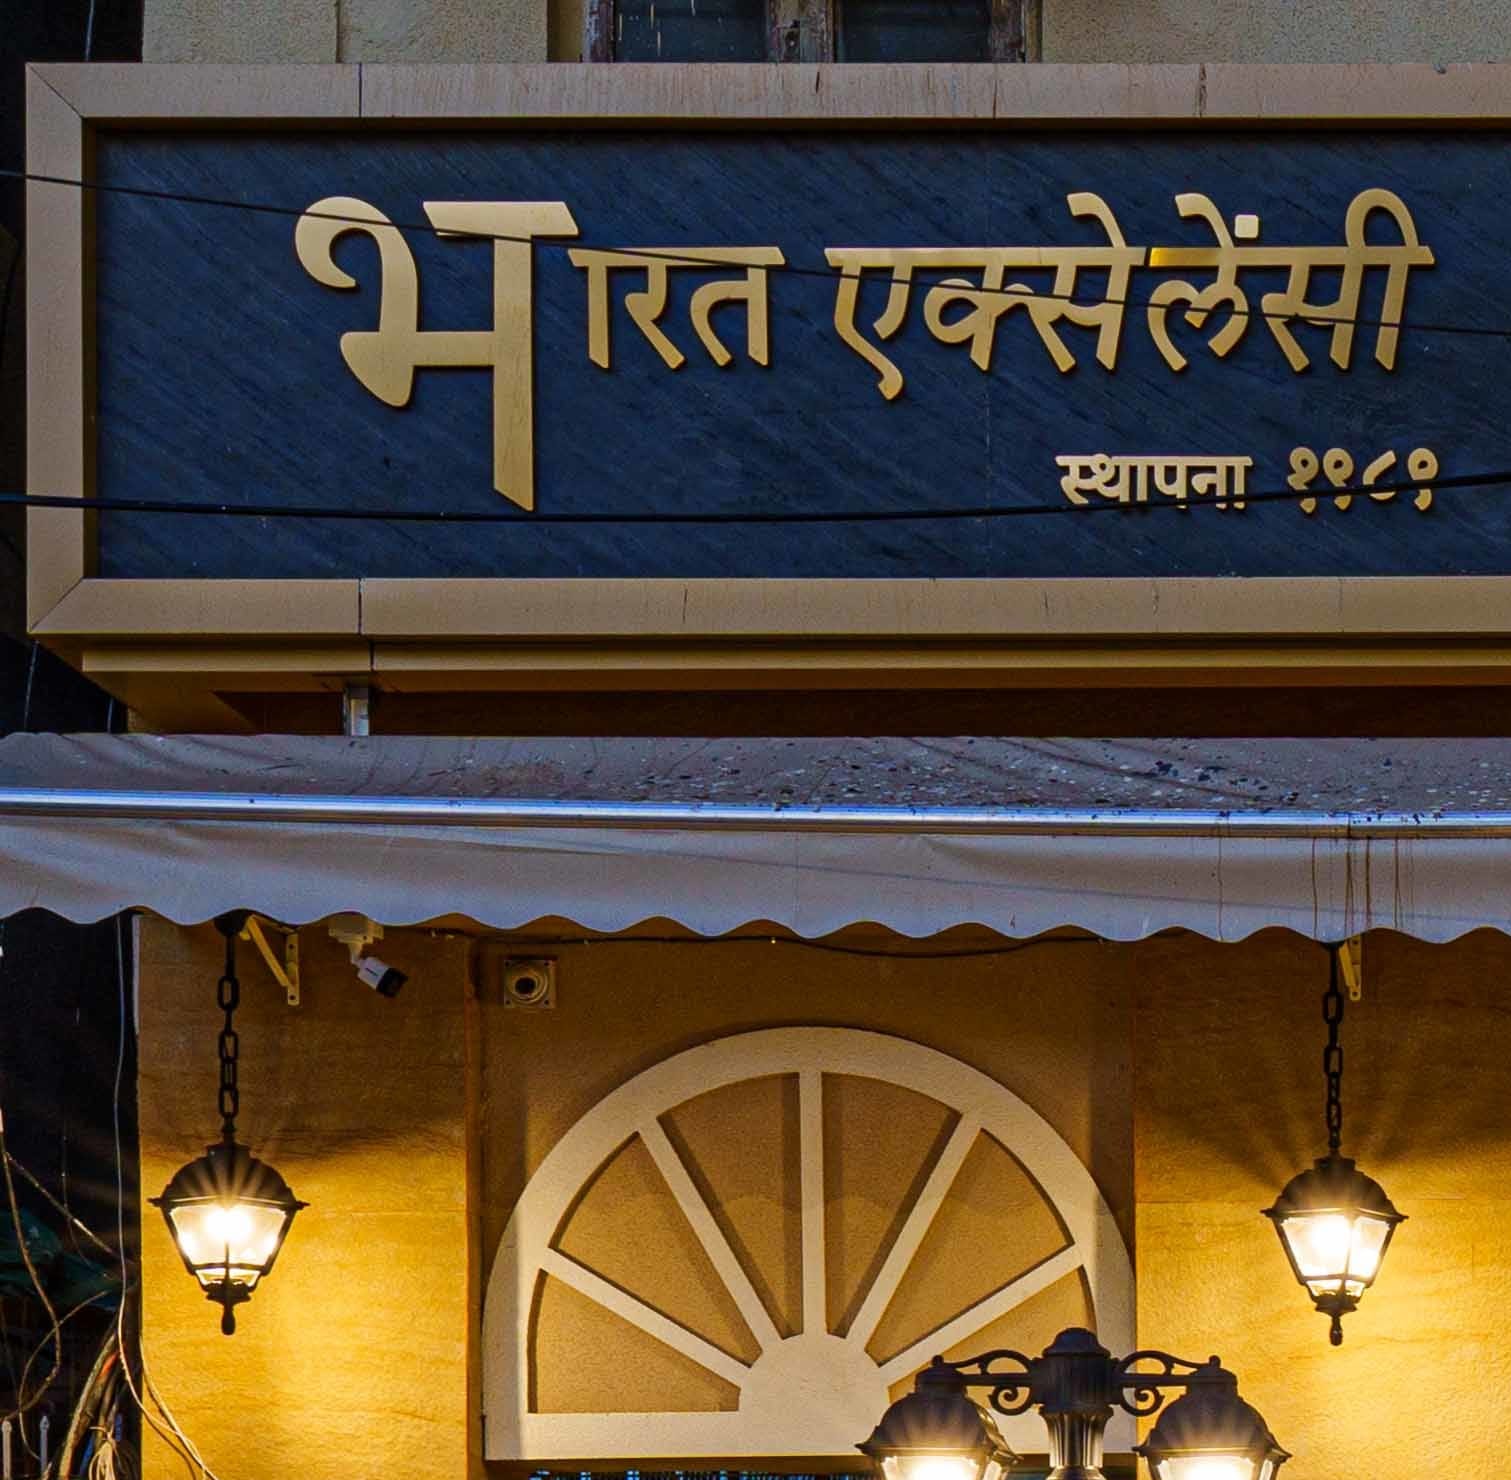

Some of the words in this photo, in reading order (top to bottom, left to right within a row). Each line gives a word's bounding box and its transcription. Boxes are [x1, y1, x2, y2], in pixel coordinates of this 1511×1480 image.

[296, 196, 785, 512] भारत
[824, 188, 1434, 400] एक्सेलेंसी
[1055, 453, 1252, 509] स्थापना
